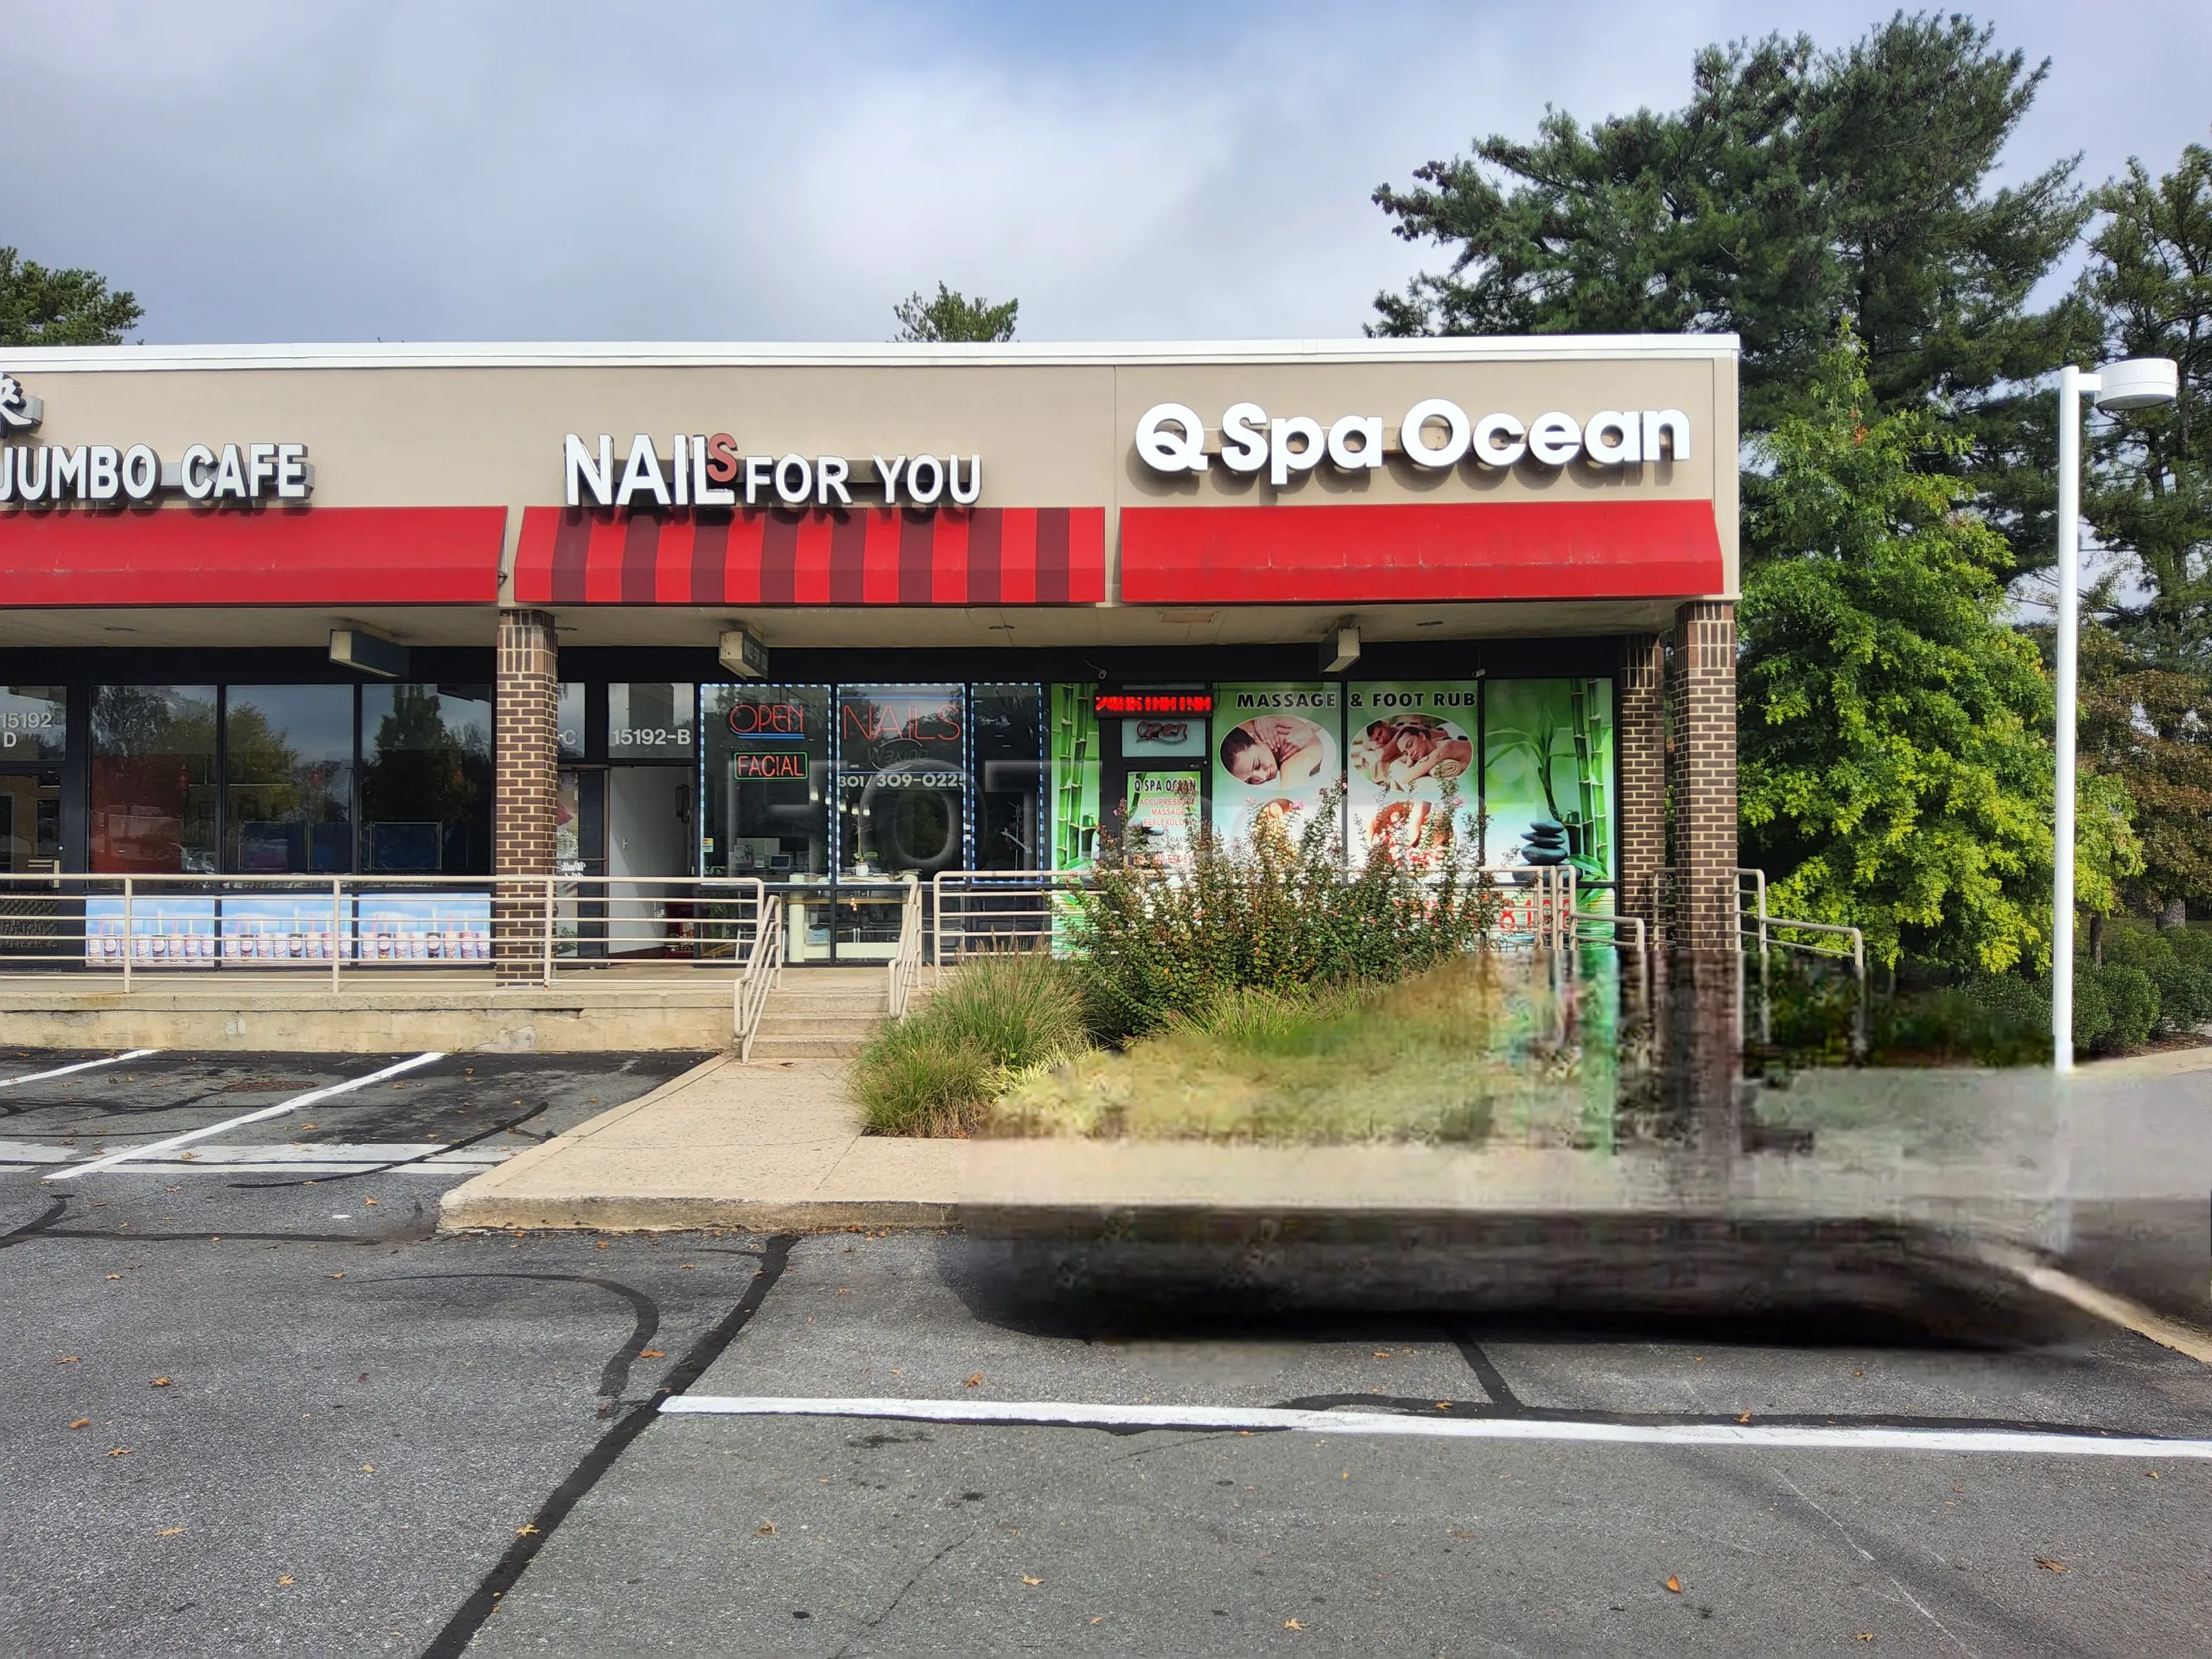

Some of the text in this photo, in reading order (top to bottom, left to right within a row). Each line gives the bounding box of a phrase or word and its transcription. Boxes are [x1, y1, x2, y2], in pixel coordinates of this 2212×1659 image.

[1135, 398, 1690, 486] Q Spa Ocean
[0, 442, 308, 501] JUMBO CAFE
[564, 432, 982, 505] NAILS FOR YOU
[1236, 692, 1476, 708] MASSAGE & FOOT RUB
[0, 712, 53, 728] 15192
[729, 704, 804, 734] OPEN
[842, 704, 961, 741] NAILS
[3, 732, 17, 747] D
[612, 728, 691, 745] 15192-B
[737, 755, 804, 777] FACIAL
[1134, 779, 1141, 791] Q
[1144, 779, 1162, 791] SPA
[1143, 818, 1193, 827] REFLEXOLOY
